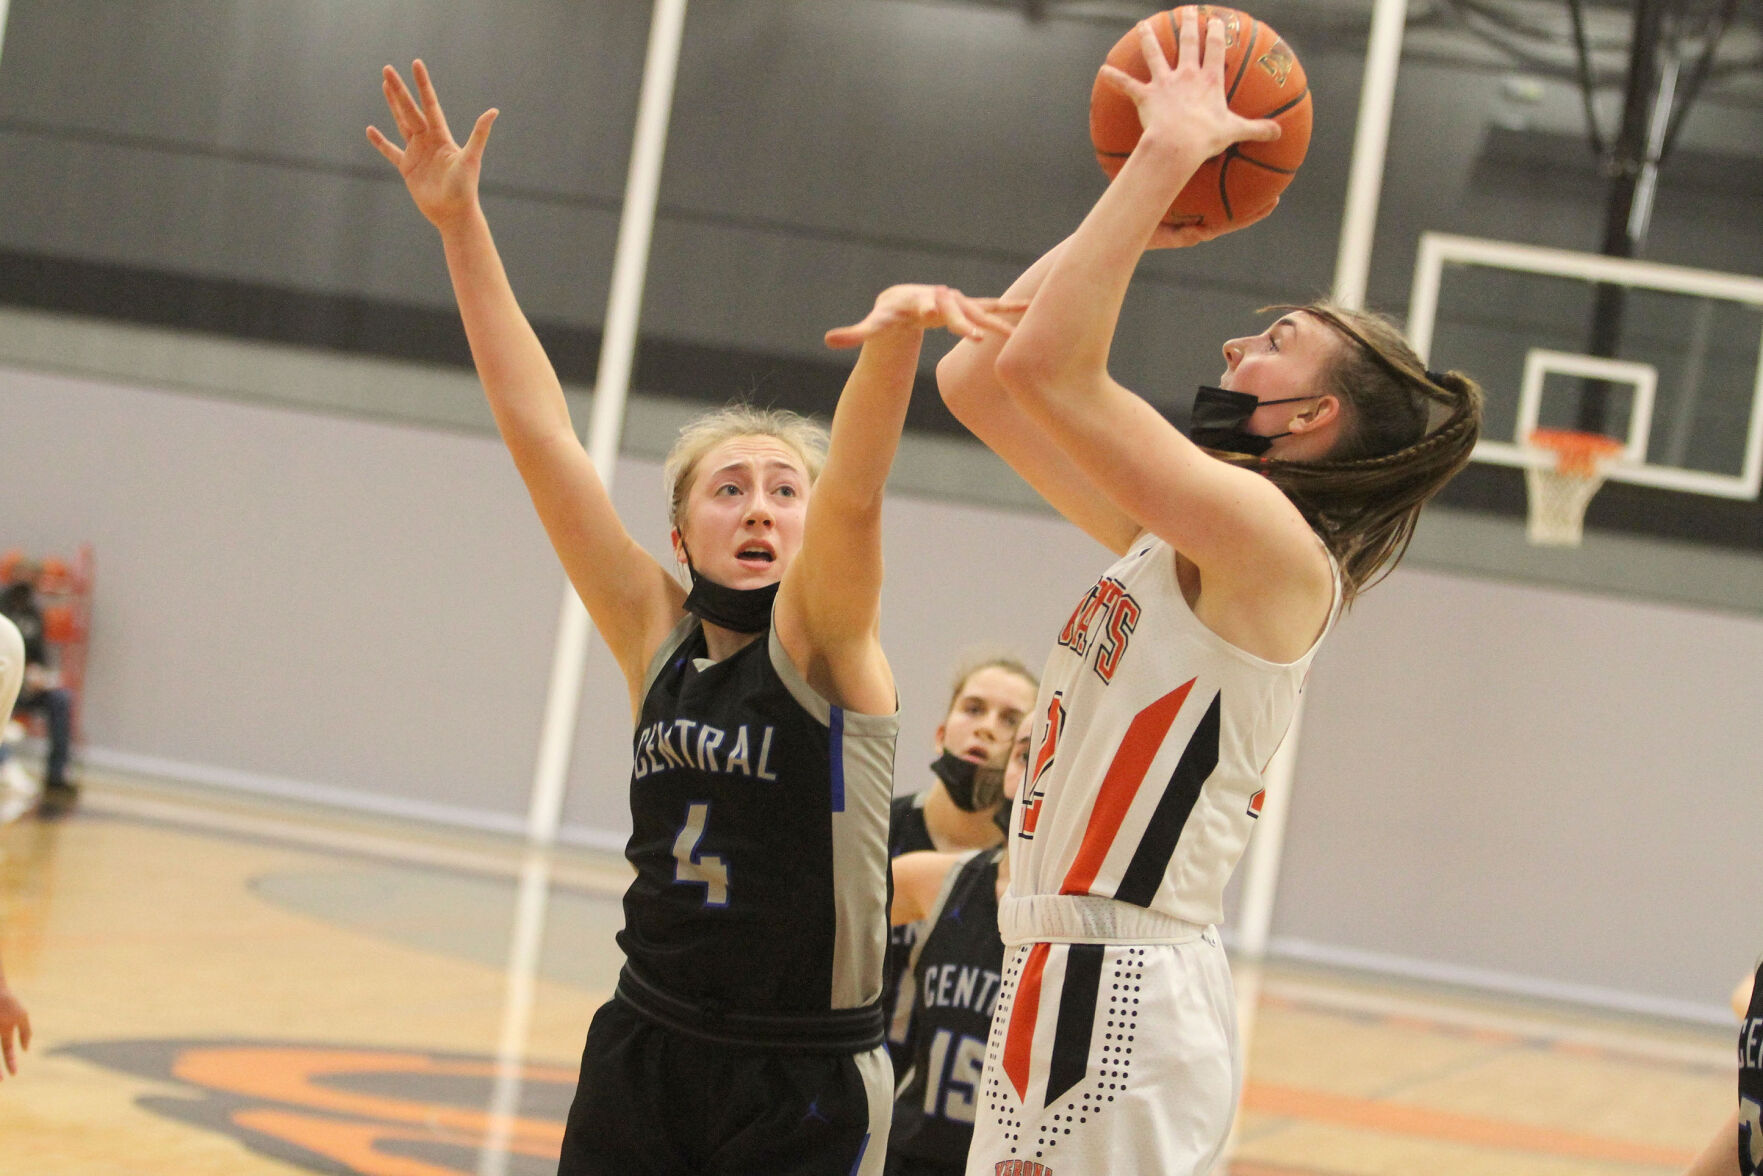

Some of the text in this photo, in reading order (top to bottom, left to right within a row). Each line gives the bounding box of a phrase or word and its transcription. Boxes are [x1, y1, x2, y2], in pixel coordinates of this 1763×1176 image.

[634, 718, 777, 781] CENTRAL
[671, 801, 733, 908] 4
[923, 1028, 988, 1124] 15
